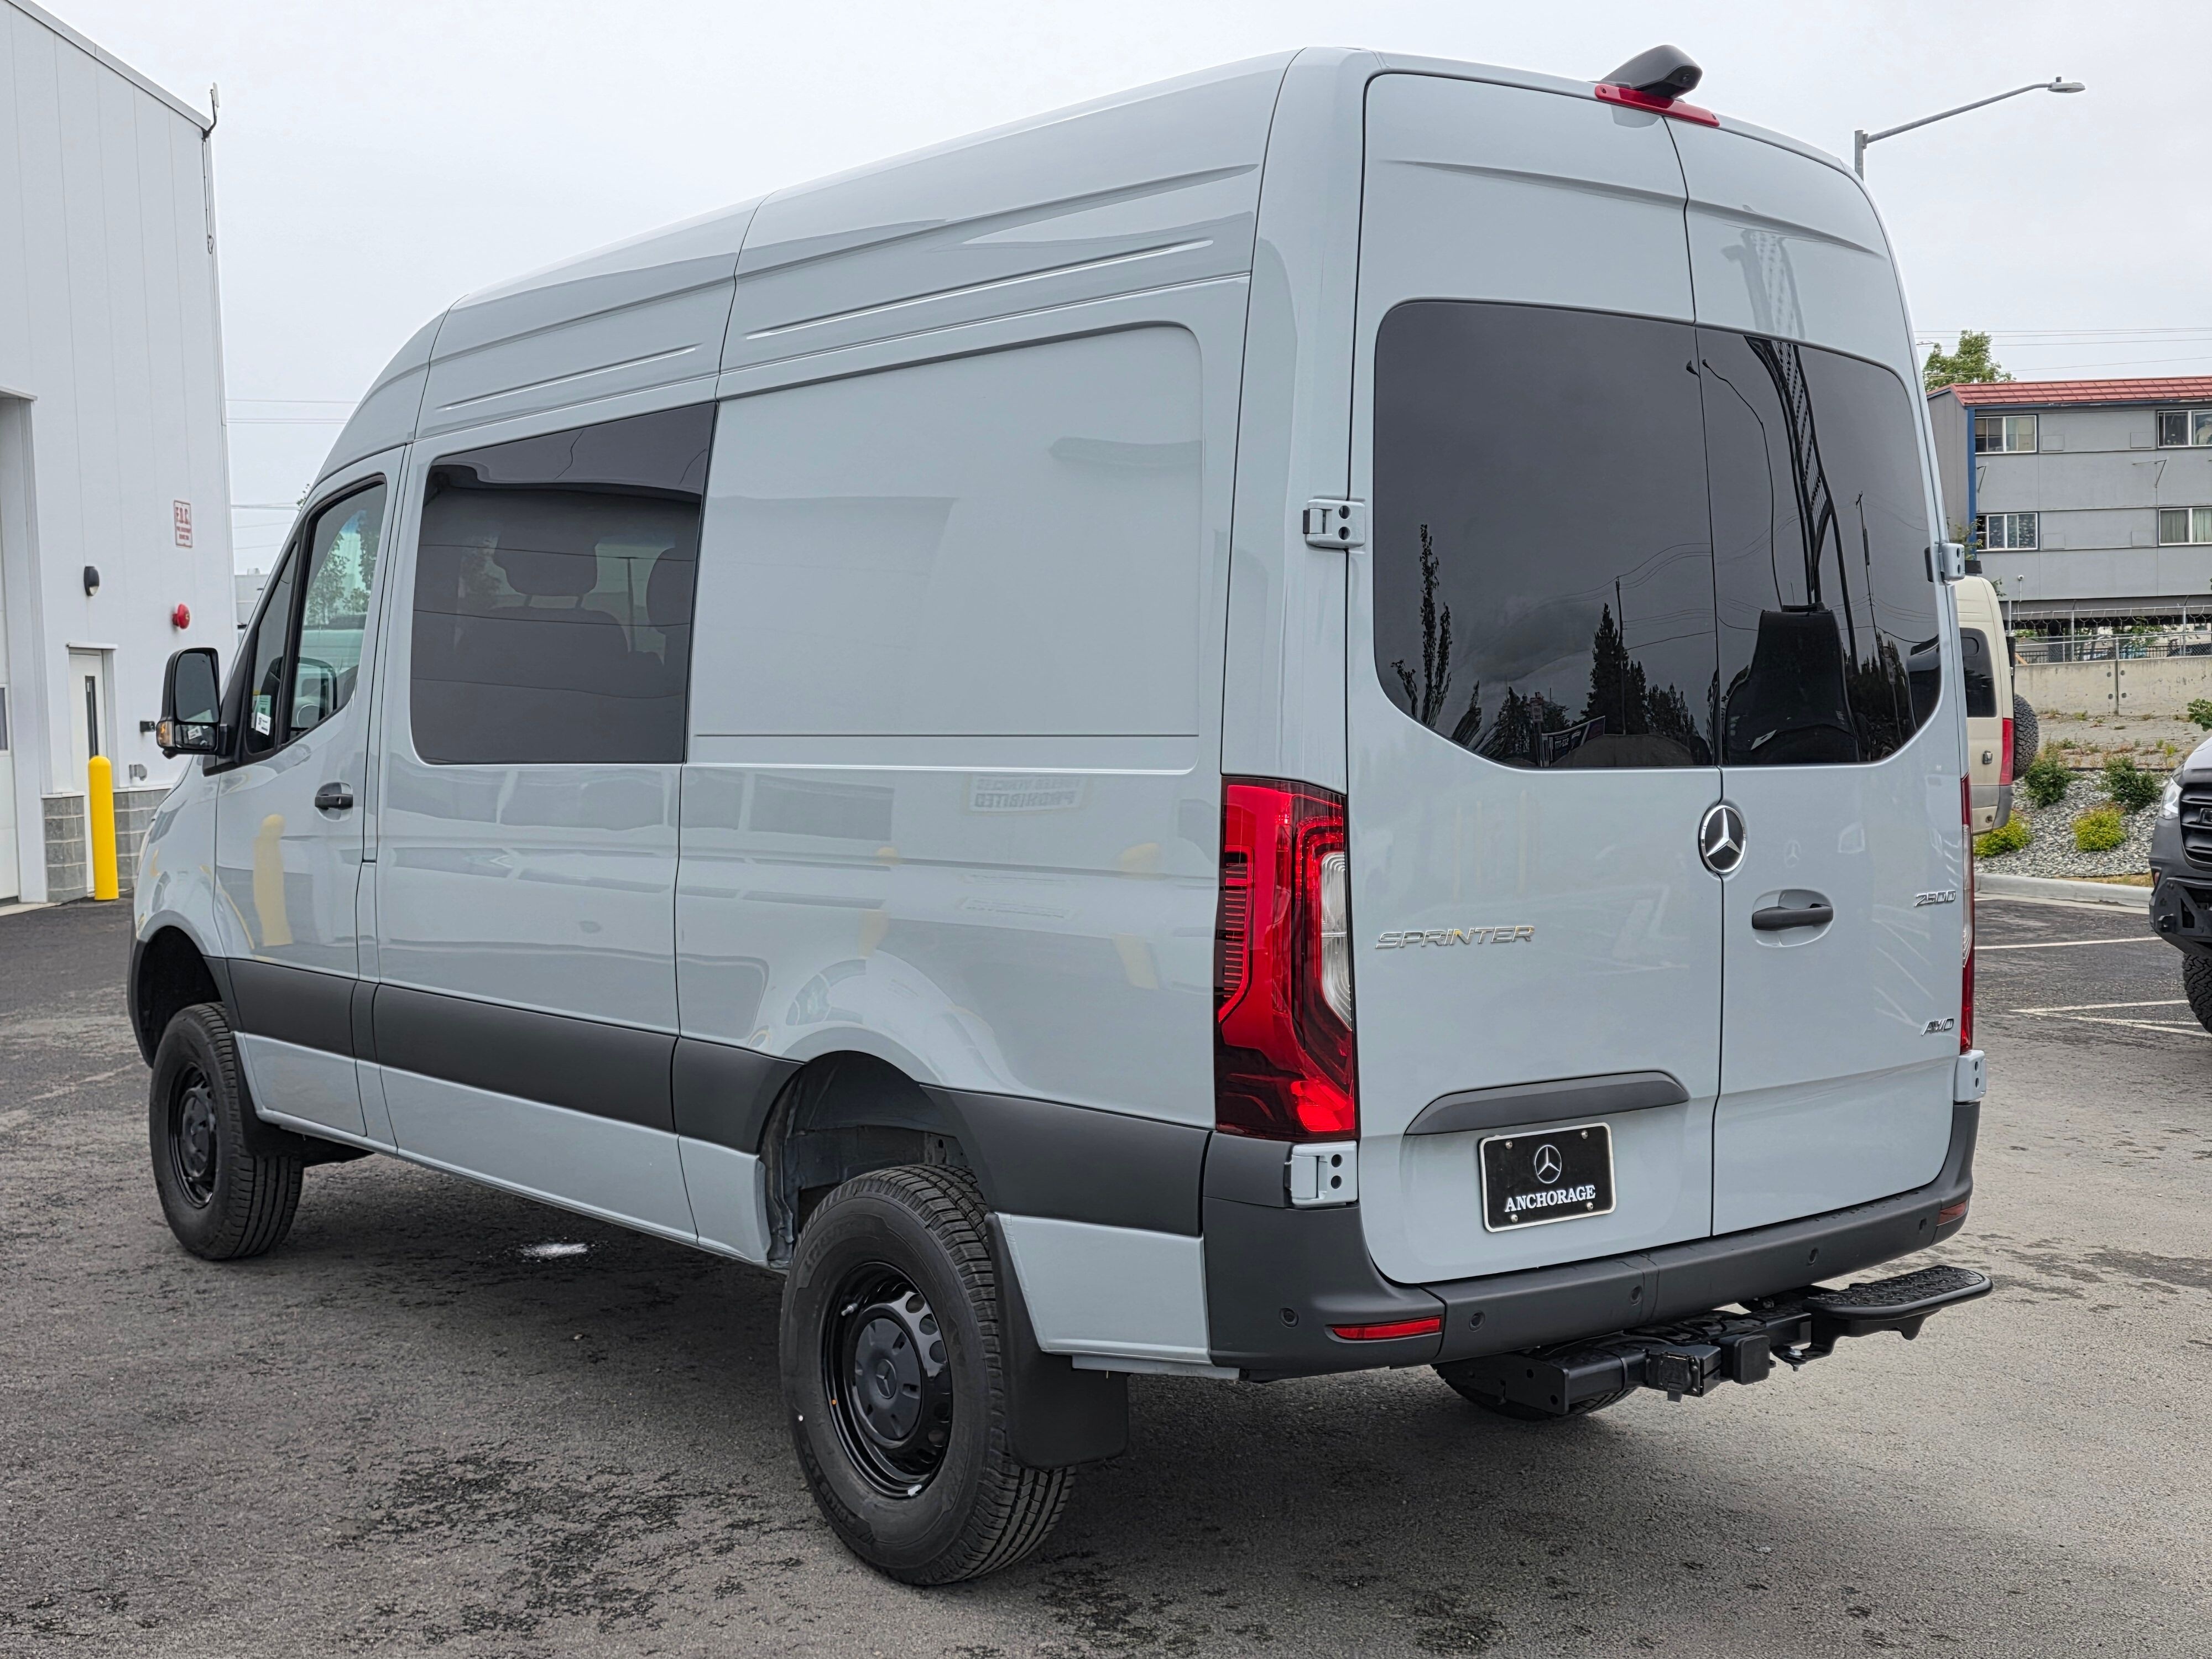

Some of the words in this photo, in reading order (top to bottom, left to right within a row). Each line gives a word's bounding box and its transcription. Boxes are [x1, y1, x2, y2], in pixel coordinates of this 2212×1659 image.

[1914, 890, 1956, 907] 2500
[1375, 925, 1535, 949] SPRINTER
[1504, 1185, 1596, 1213] ANCHORAGE
